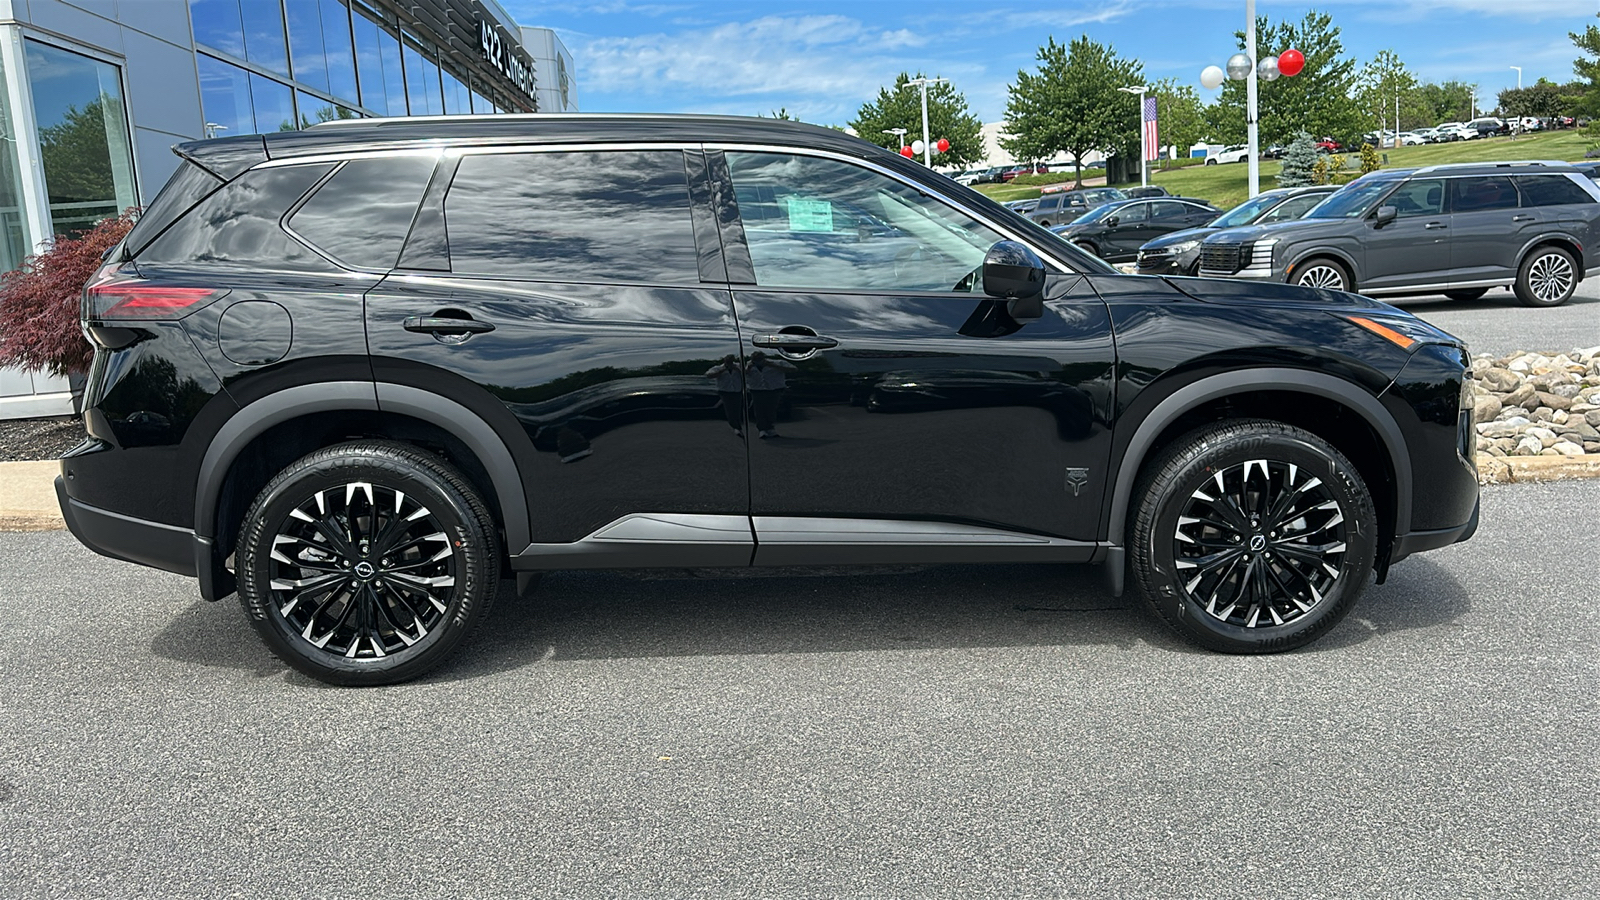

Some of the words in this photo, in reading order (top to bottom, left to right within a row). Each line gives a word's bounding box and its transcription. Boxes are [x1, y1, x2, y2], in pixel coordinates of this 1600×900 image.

[482, 19, 503, 72] 422
[1174, 437, 1271, 490] BRIDGESTONE
[243, 515, 269, 621] BRIDGESTONE
[452, 524, 479, 630] BRIDGESTONE
